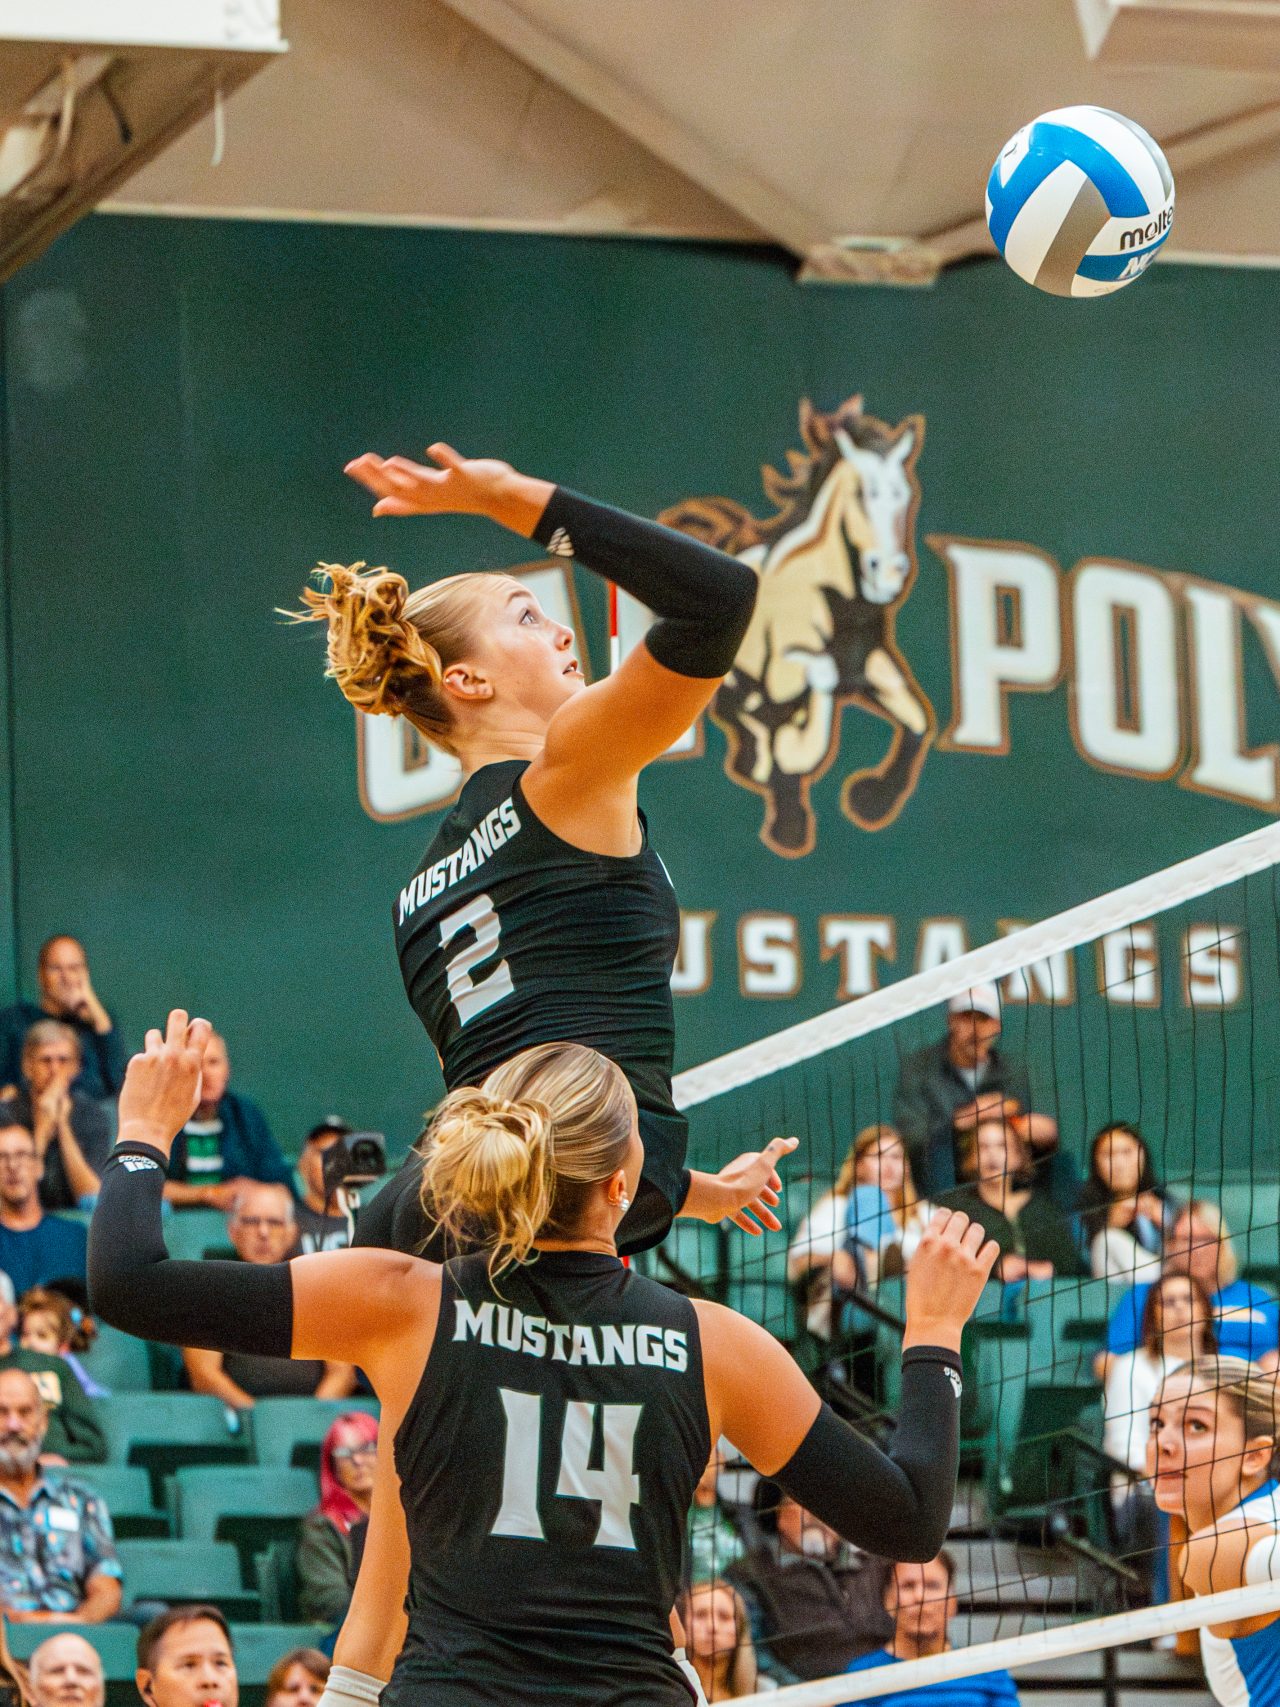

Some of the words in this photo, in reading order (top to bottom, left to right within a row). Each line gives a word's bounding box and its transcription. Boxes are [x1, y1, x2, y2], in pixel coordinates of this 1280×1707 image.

[398, 796, 523, 928] MUSTANGS
[438, 893, 515, 1028] 2
[668, 911, 1247, 1009] USTANGS
[452, 1299, 688, 1373] MUSTANGS
[490, 1387, 644, 1551] 14
